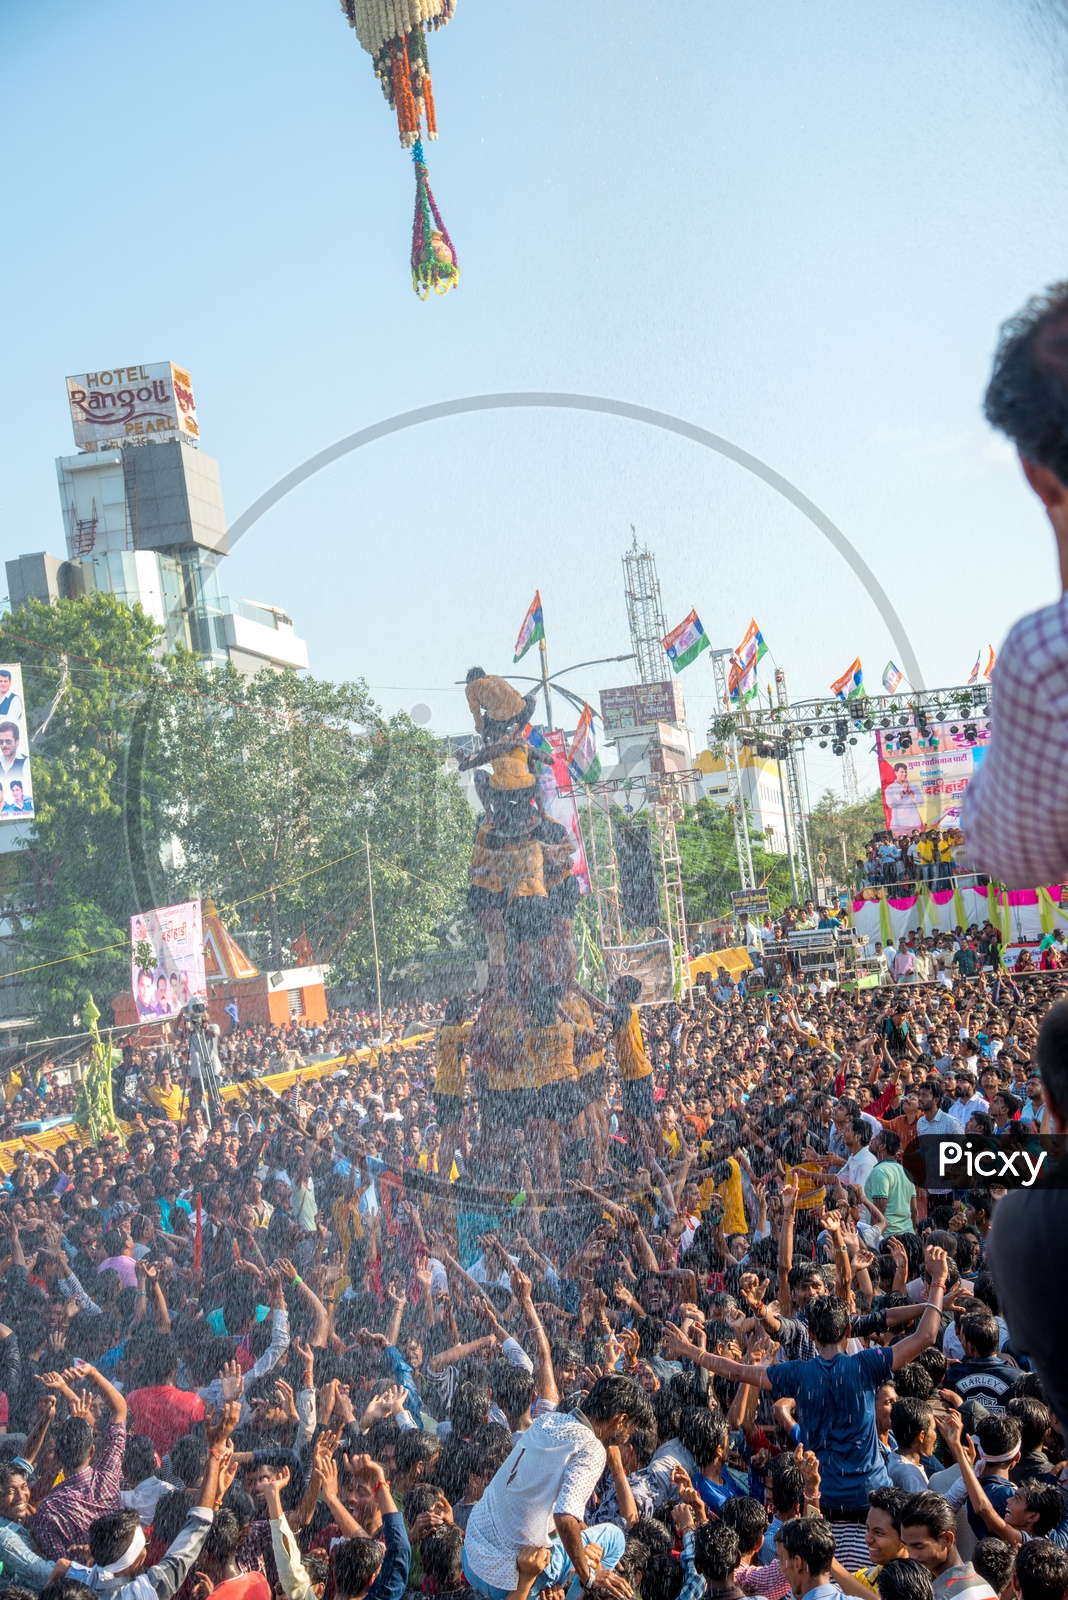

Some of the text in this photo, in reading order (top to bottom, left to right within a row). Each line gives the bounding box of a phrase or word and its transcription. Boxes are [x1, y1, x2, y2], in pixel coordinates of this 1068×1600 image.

[86, 366, 150, 388] HOTEL
[71, 380, 170, 424] Rangoli
[125, 417, 176, 436] PEARL
[953, 753, 968, 762] पार्टी
